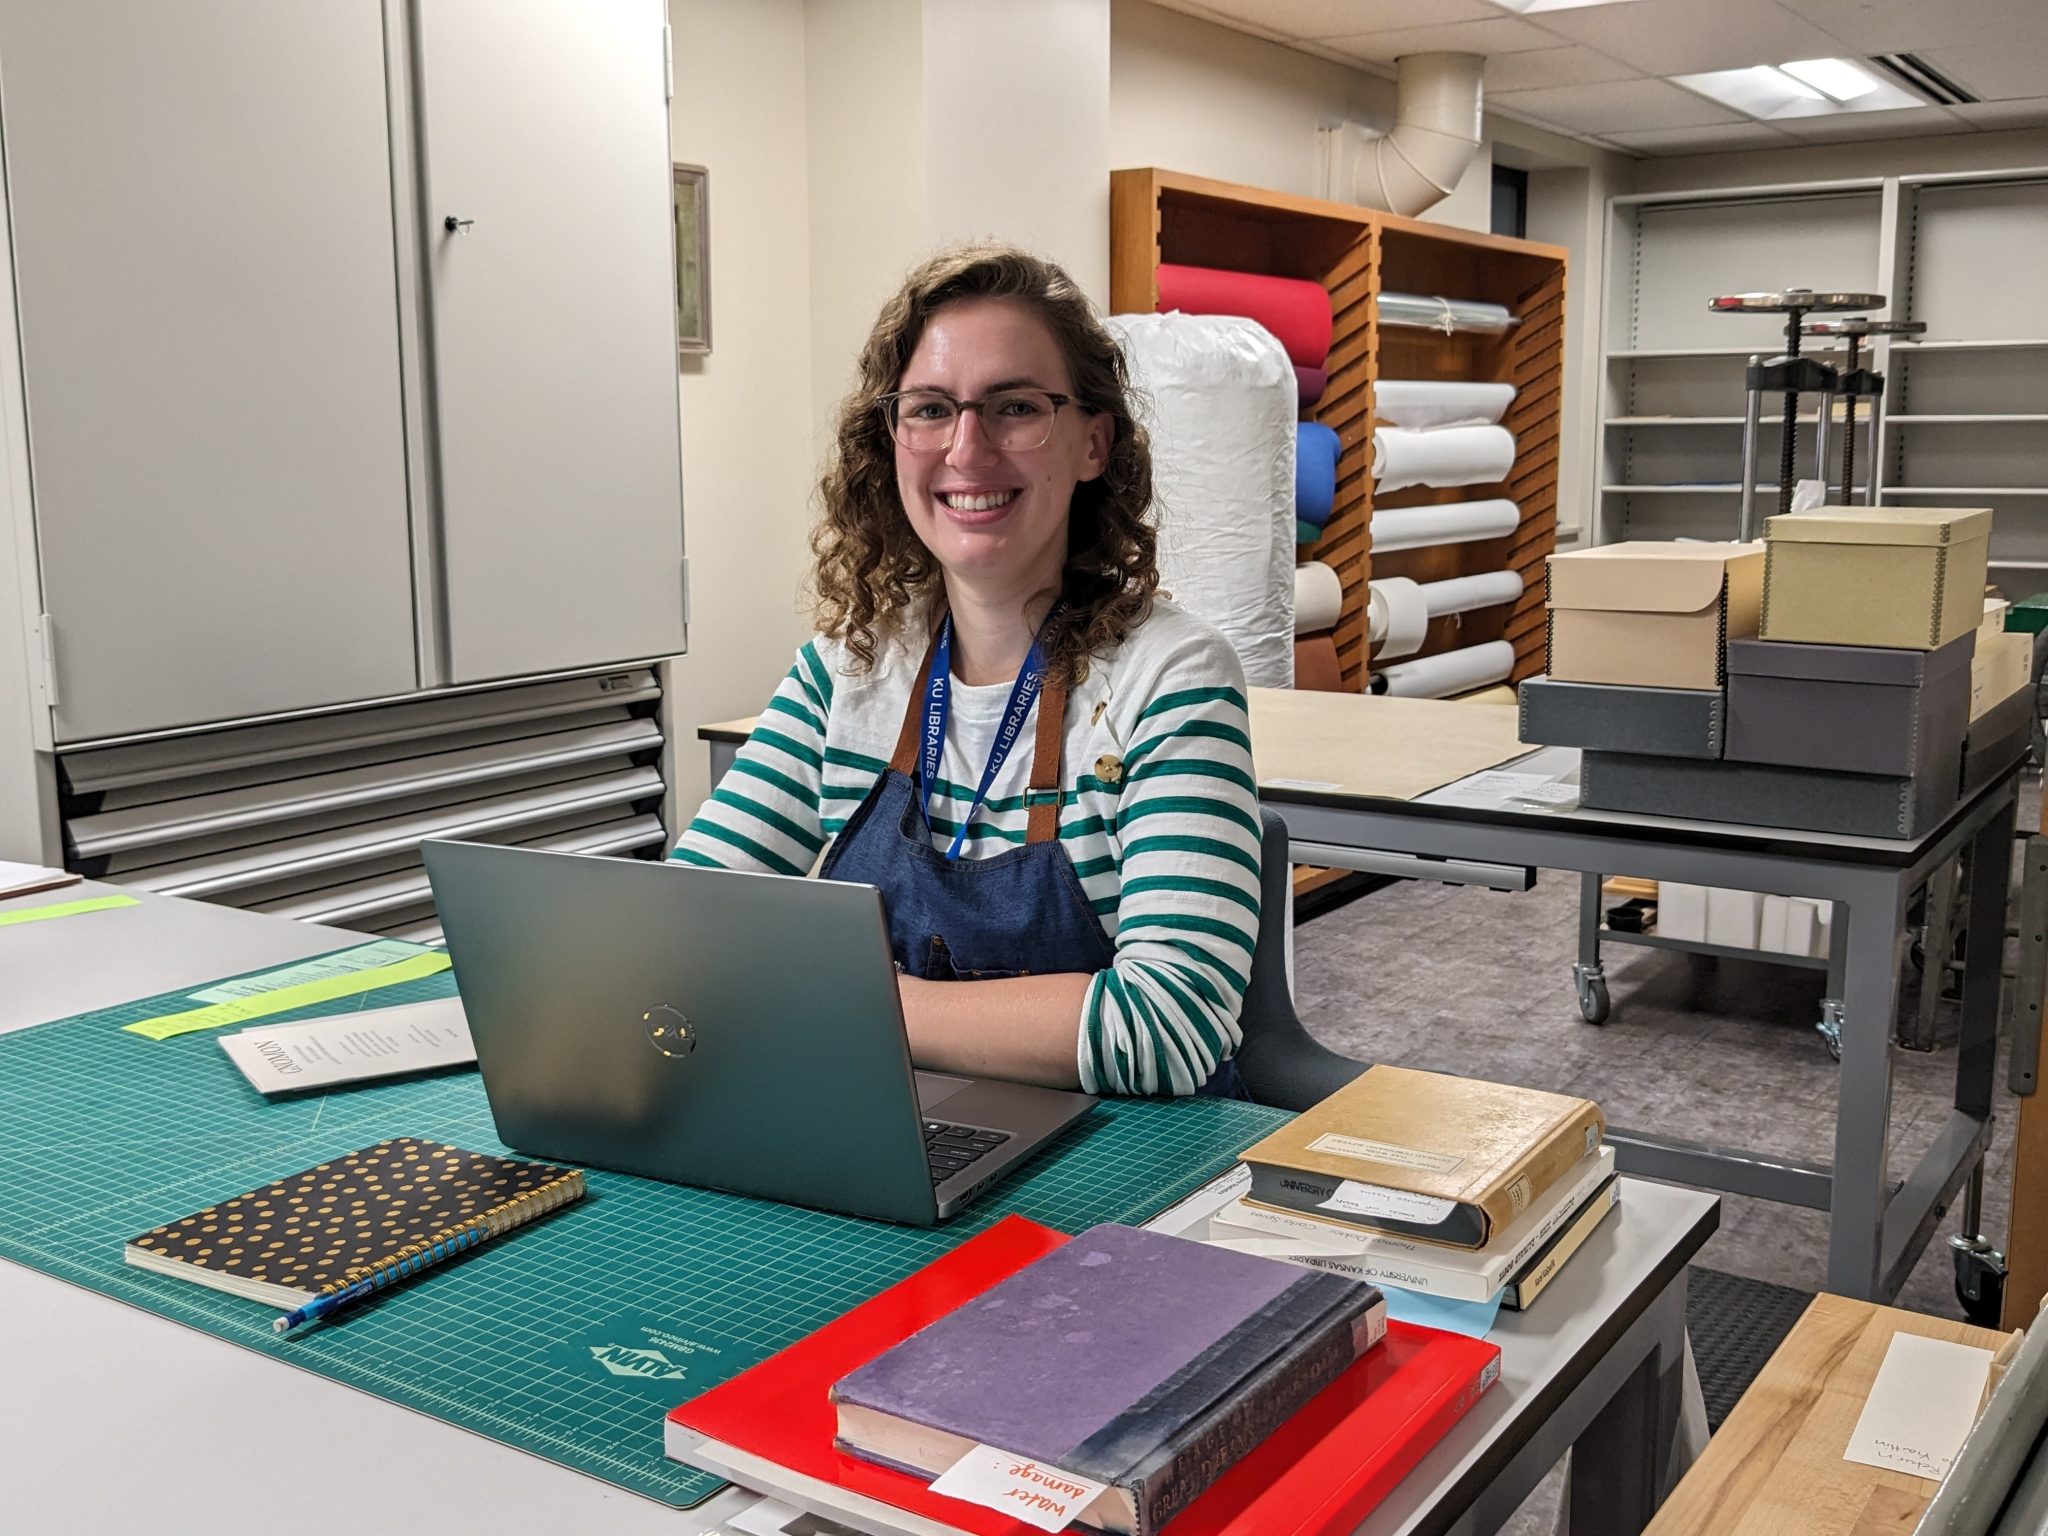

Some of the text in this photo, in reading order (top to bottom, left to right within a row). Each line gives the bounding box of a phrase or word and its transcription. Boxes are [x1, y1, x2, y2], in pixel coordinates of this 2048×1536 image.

[926, 677, 945, 780] KU LIBRARIES
[989, 671, 1038, 774] KU LIBRARIES
[1250, 1211, 1416, 1251] Thomas Doktor Carla Spies
[1328, 1261, 1365, 1273] KANSAS
[1365, 1268, 1378, 1277] OF
[1379, 1270, 1428, 1286] UNIVERSITY
[640, 1326, 722, 1355] www.alvinco.com
[594, 1345, 688, 1379] ALVIN
[1878, 1451, 1941, 1475] Return
[1002, 1489, 1066, 1516] water
